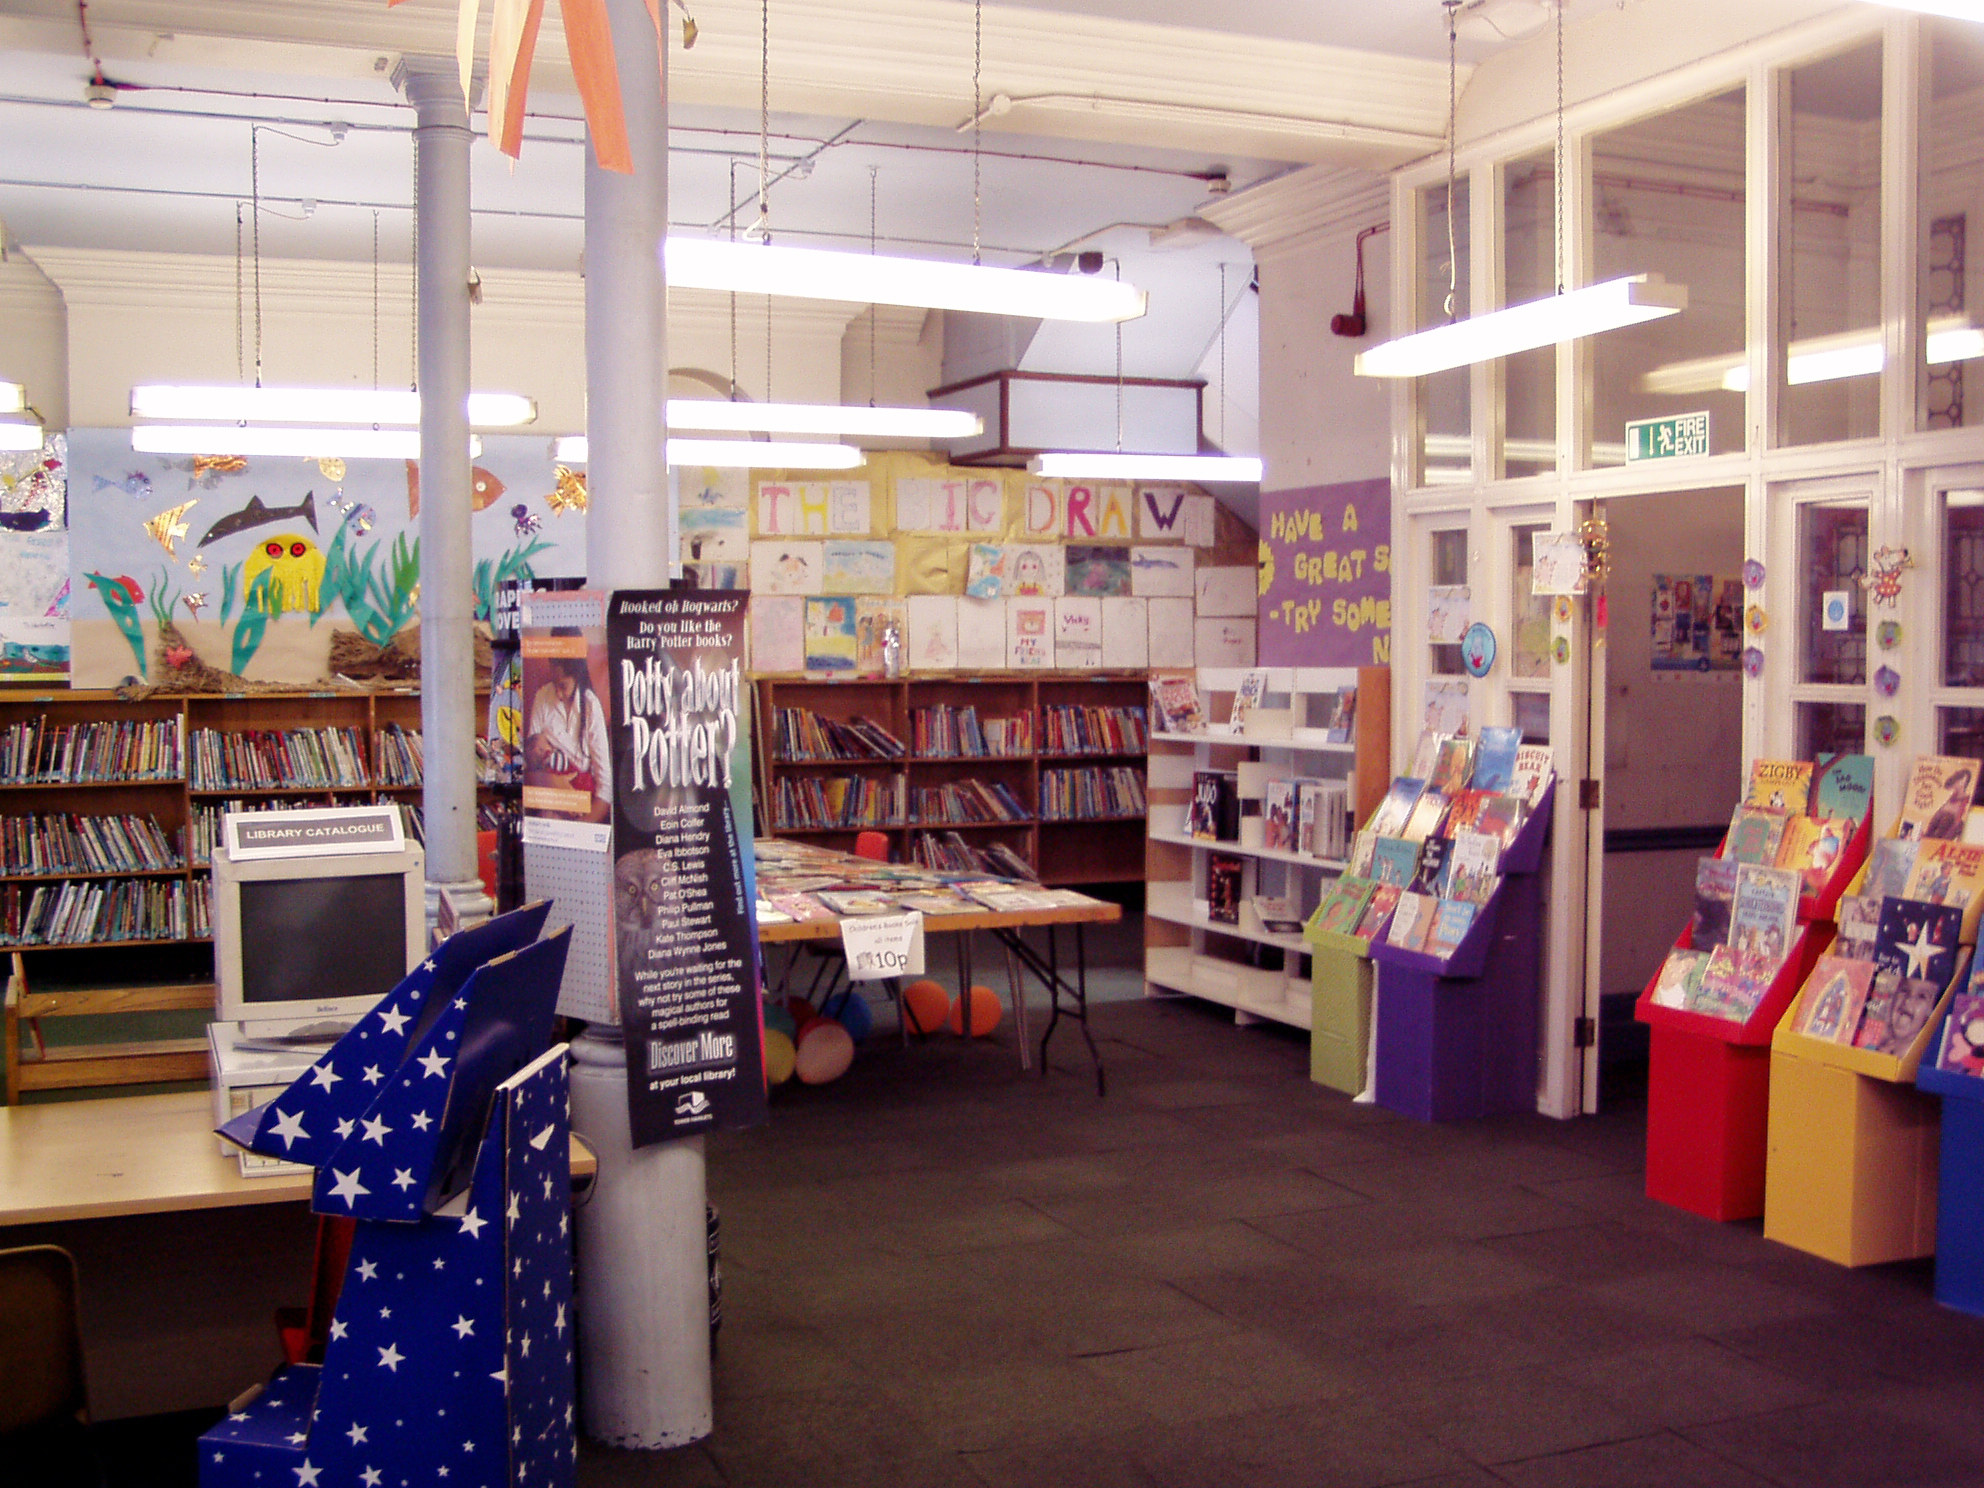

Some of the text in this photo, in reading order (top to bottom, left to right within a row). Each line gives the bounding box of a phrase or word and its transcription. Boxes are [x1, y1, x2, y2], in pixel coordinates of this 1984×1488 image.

[1674, 415, 1705, 438] FIRE
[1675, 434, 1705, 456] EXIT
[761, 485, 859, 533] THE
[1028, 485, 1185, 537] DRAW
[1270, 503, 1358, 544] HAVE A
[1294, 549, 1367, 586] GREAT
[620, 600, 662, 614] Hooked
[681, 600, 738, 616] Hogwarts?
[640, 618, 722, 636] Do you like the
[626, 634, 732, 652] Harry Potter books?
[621, 656, 740, 727] Potty about
[631, 707, 737, 792] Potter?
[1760, 764, 1802, 780] ZIGBY
[654, 802, 710, 816] David Almond
[246, 823, 384, 840] LIBRARY CATALOGUE
[660, 818, 704, 830] Eoin Colfer
[656, 831, 710, 845] Diana Hendry
[657, 846, 710, 860] Eva Ibbotson
[682, 860, 705, 870] Lewis
[678, 873, 708, 884] McNish
[664, 888, 708, 900] Pat O'Shea
[658, 900, 714, 916] Philip Pullman
[662, 914, 712, 929] Paul Stewart
[656, 928, 718, 944] Kate Thompson
[648, 941, 728, 960] Diana Wynne Jones
[634, 958, 742, 981] While you're waiting for the
[876, 950, 908, 971] 10p
[643, 972, 734, 993] next story in the series,
[638, 984, 741, 1008] why not try some of these
[652, 998, 728, 1018] magical authors for
[651, 1010, 730, 1031] a spell-binding read
[650, 1031, 734, 1070] Discover More
[649, 1067, 736, 1091] at your local library!
